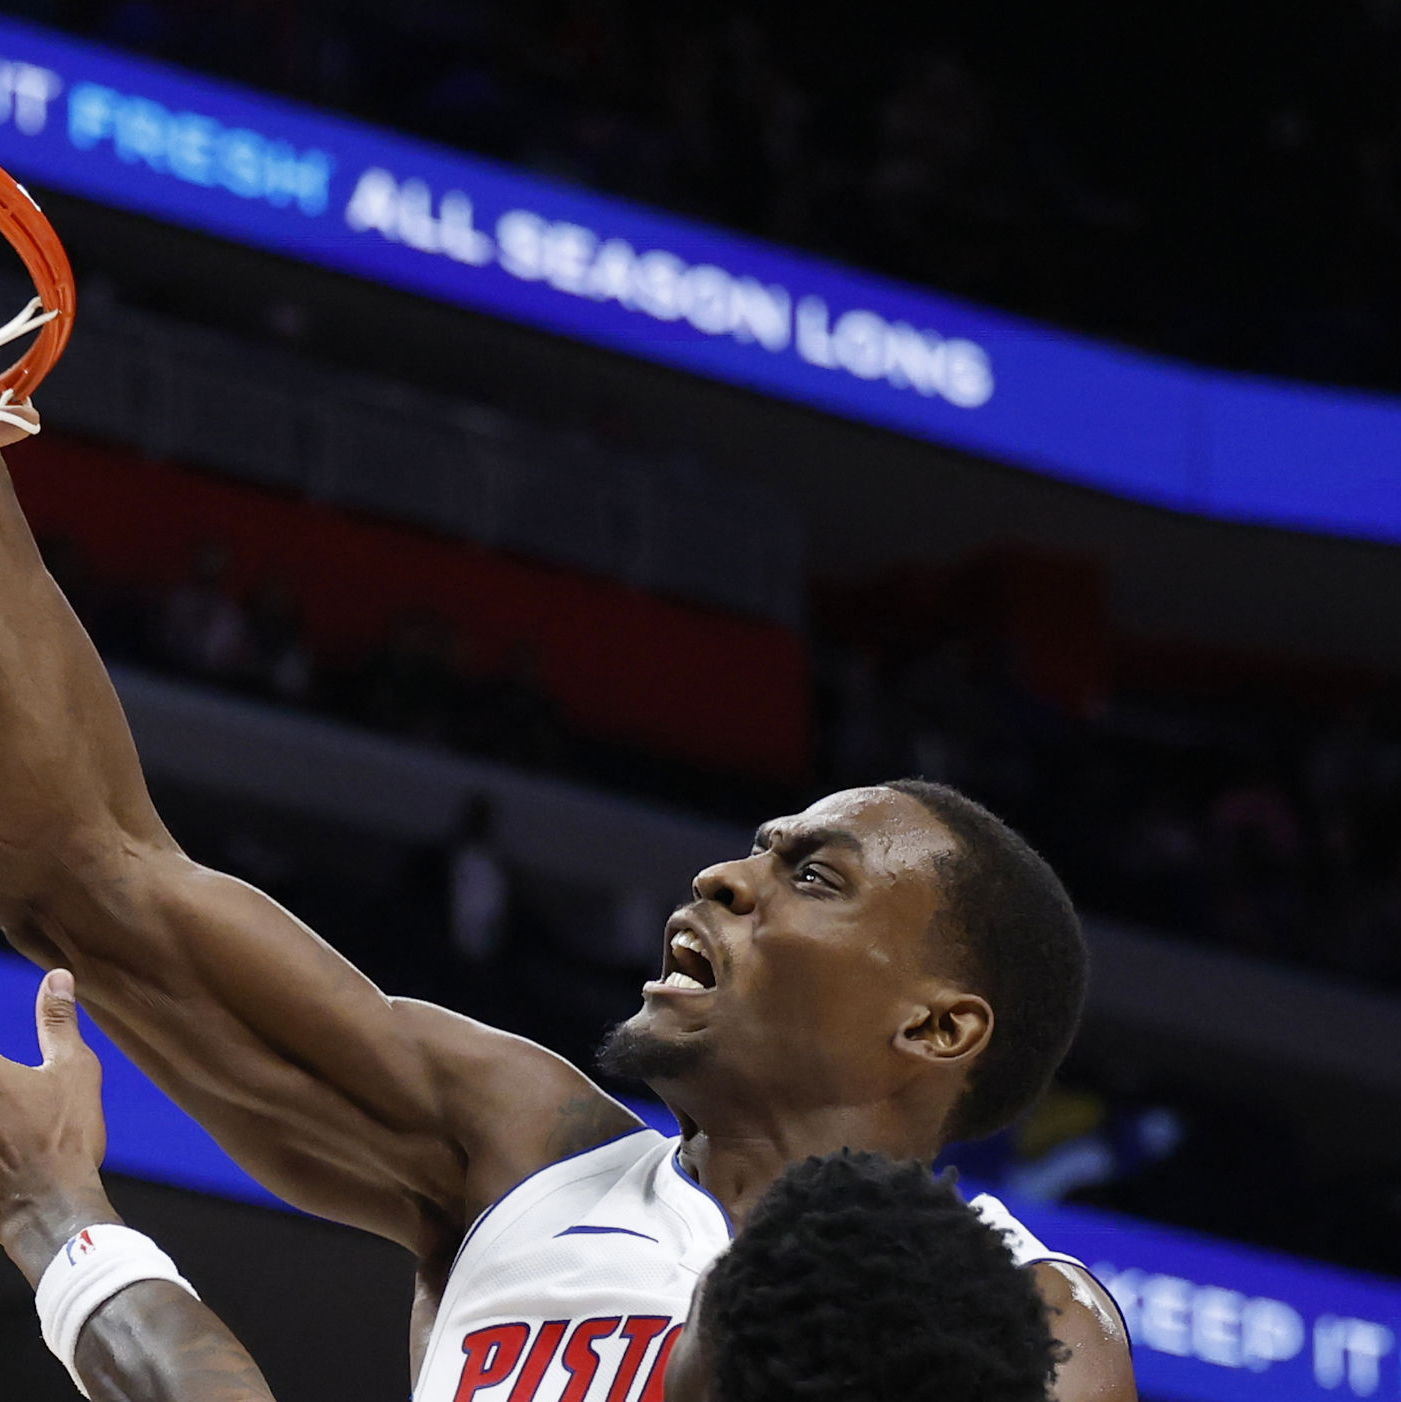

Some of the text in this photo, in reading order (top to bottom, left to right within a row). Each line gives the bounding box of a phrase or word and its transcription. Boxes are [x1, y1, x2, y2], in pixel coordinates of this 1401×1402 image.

[67, 80, 332, 214] FRESH
[345, 166, 496, 266] ALL
[497, 208, 792, 351] SEASON
[795, 295, 994, 408] LONG
[1312, 1315, 1394, 1397] IT
